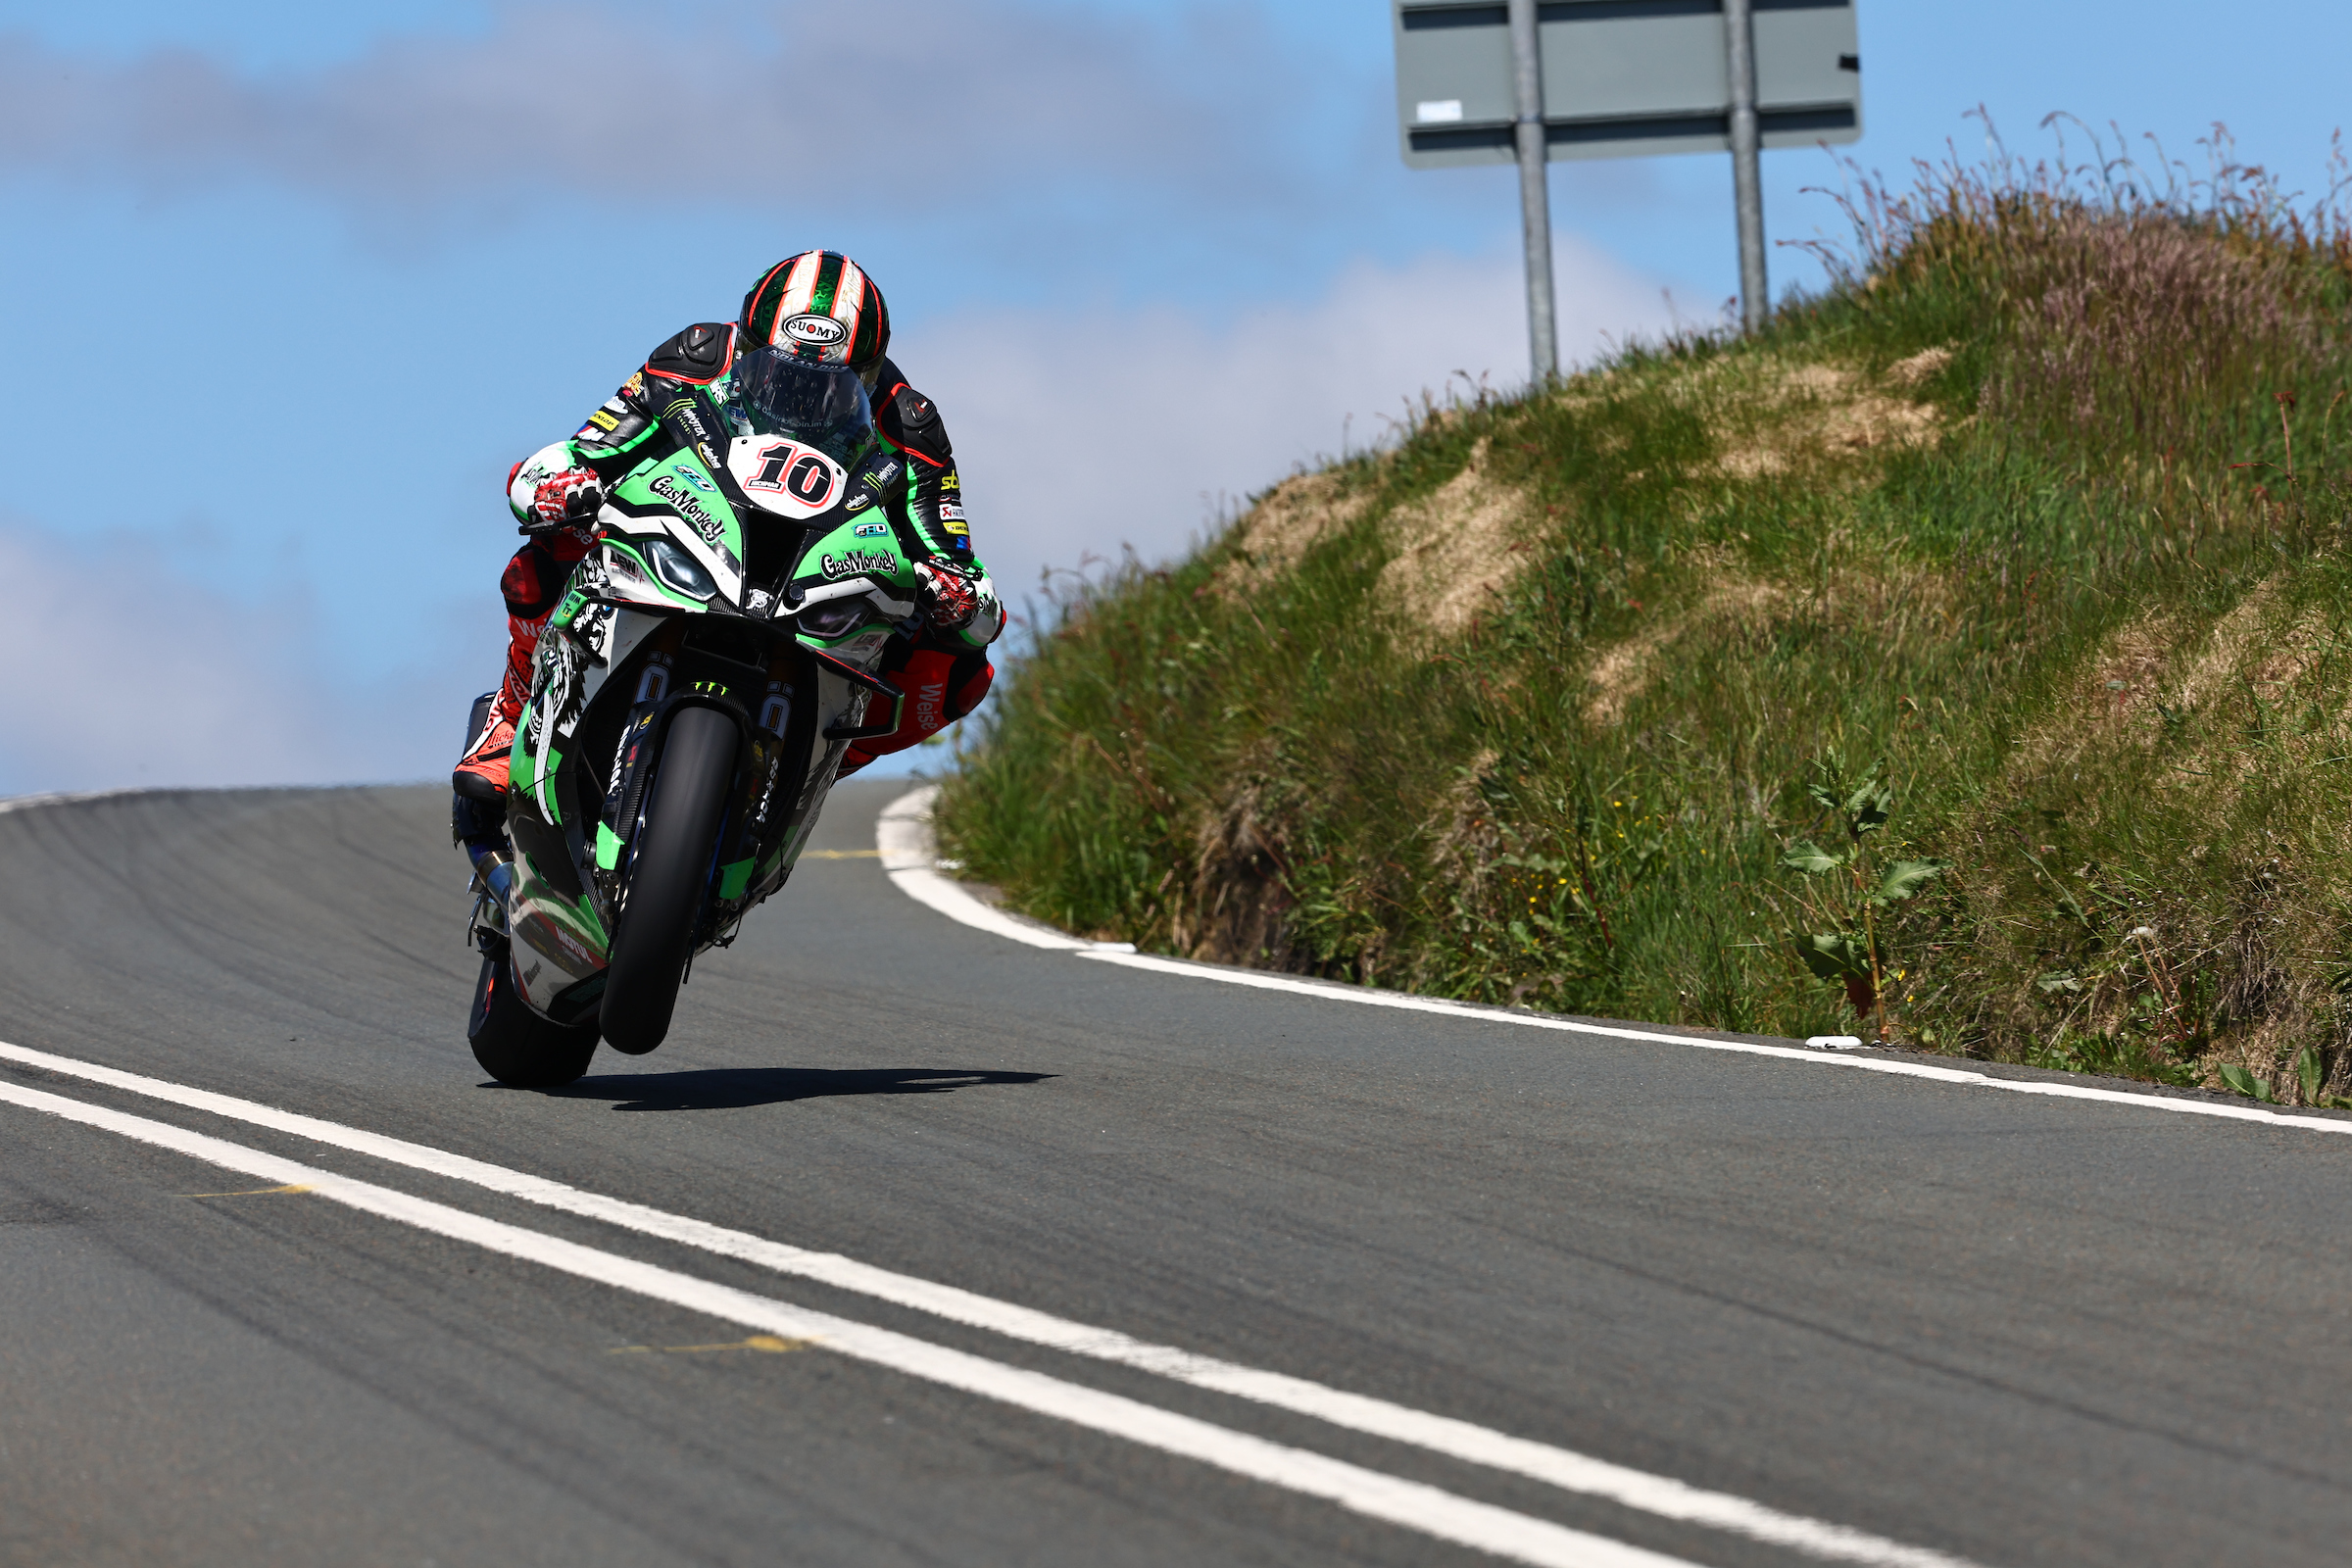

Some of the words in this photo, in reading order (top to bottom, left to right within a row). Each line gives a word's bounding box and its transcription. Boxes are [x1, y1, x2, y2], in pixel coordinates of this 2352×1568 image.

[790, 319, 840, 341] SUOMY
[701, 443, 722, 468] alpha
[748, 444, 832, 505] 10
[846, 493, 869, 509] alpha
[917, 683, 943, 730] Weise
[556, 925, 593, 964] MOTUL
